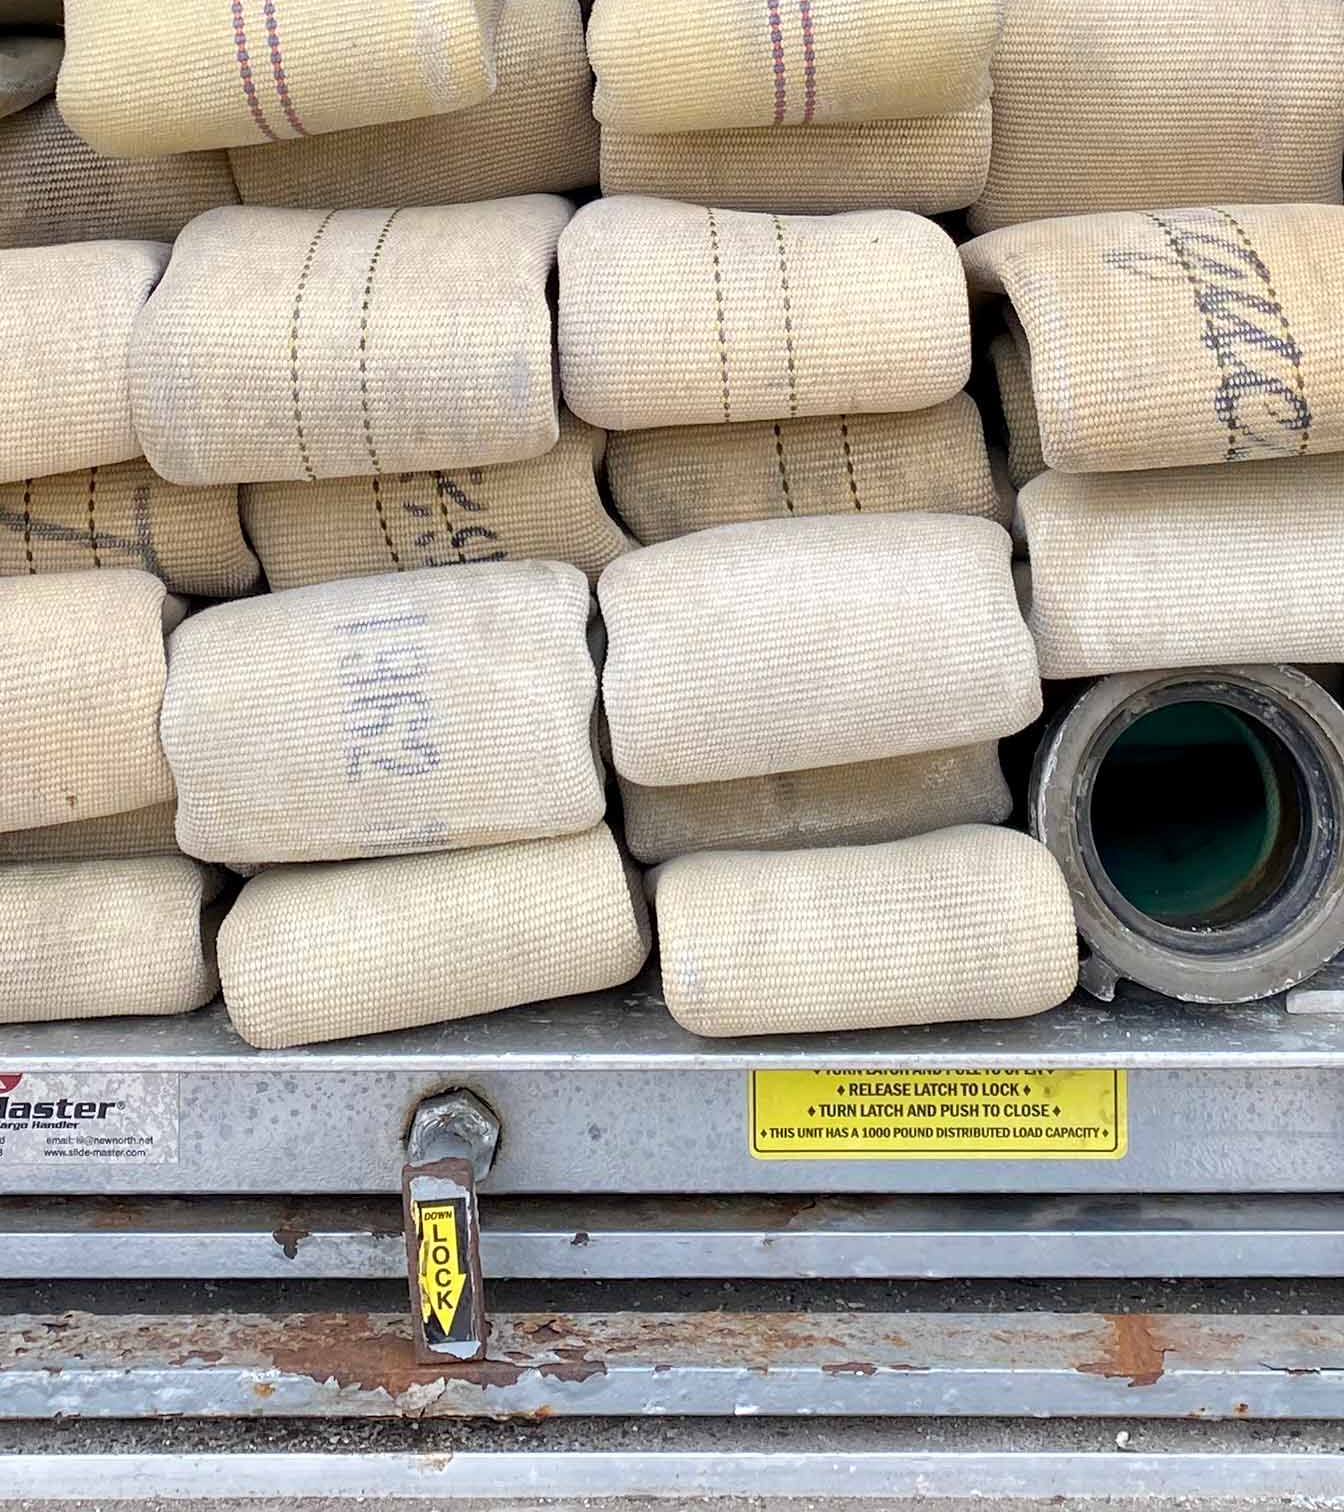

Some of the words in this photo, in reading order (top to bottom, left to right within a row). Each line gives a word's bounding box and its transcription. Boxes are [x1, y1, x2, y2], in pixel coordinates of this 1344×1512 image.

[848, 1082, 912, 1097] RELEASE
[914, 1082, 958, 1097] LATCH
[960, 1082, 980, 1097] TO
[982, 1082, 1020, 1097] LOCK
[818, 1104, 857, 1117] TURN
[860, 1104, 904, 1117] LATCH
[907, 1104, 937, 1117] AND
[940, 1104, 979, 1117] PUSH
[982, 1104, 1000, 1117] TO
[1003, 1104, 1050, 1117] CLOSE
[31, 1120, 80, 1130] Handler
[769, 1127, 795, 1139] THIS
[797, 1127, 823, 1139] UNIT
[825, 1127, 849, 1139] HAS
[850, 1127, 860, 1139] A
[862, 1127, 891, 1139] 1000
[893, 1127, 934, 1139] POUND
[935, 1127, 1011, 1139] DISTRIBUTED
[1013, 1127, 1043, 1139] LOAD
[1045, 1127, 1100, 1139] CAPACITY
[44, 1148, 146, 1157] www.slide-master.com
[423, 1210, 453, 1221] DOWN
[431, 1223, 454, 1310] LOCK
